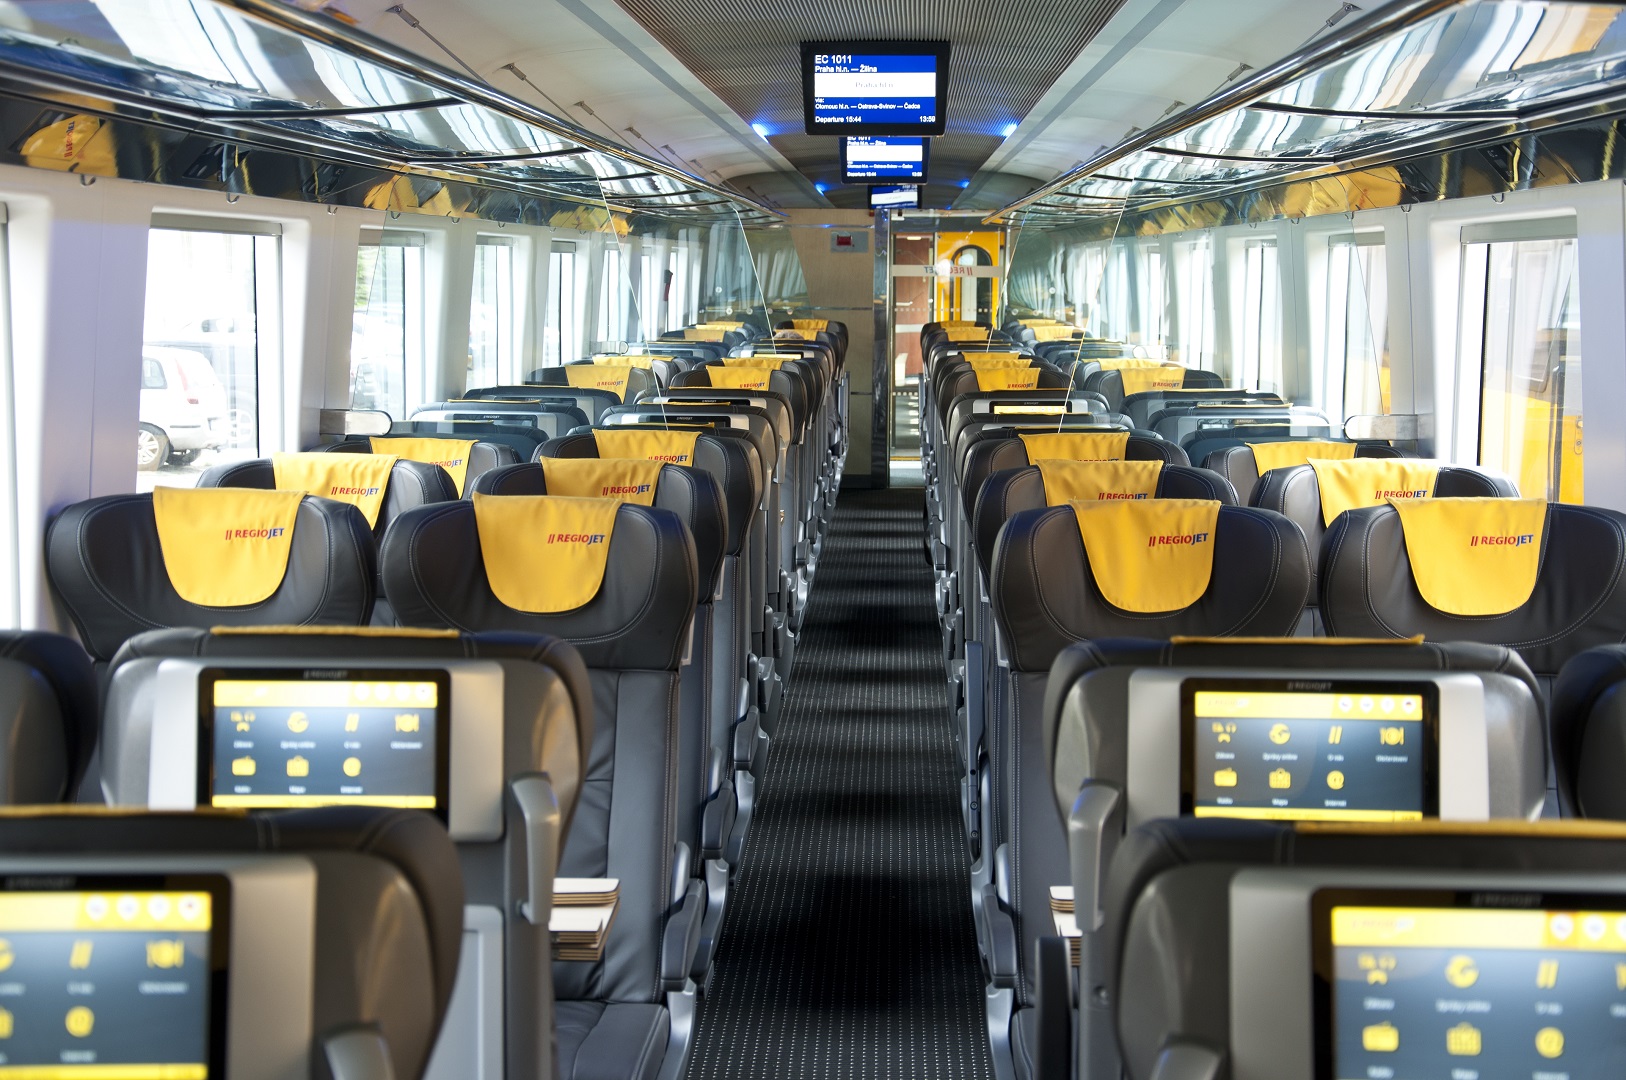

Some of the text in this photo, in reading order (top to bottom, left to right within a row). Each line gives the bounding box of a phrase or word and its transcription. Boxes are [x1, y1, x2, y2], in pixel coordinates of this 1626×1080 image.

[815, 55, 852, 64] EC 1011
[815, 65, 835, 73] Praha
[815, 115, 844, 124] Departure
[654, 455, 688, 464] REGIOJET
[340, 487, 379, 497] REGIOJET
[610, 484, 651, 494] REGIOJET
[1384, 490, 1428, 498] REGIOJET
[235, 527, 285, 540] REGIOJET
[557, 533, 605, 545] REGIOJET
[1158, 533, 1209, 546] REGIOJET
[1481, 534, 1534, 547] REGIOJET
